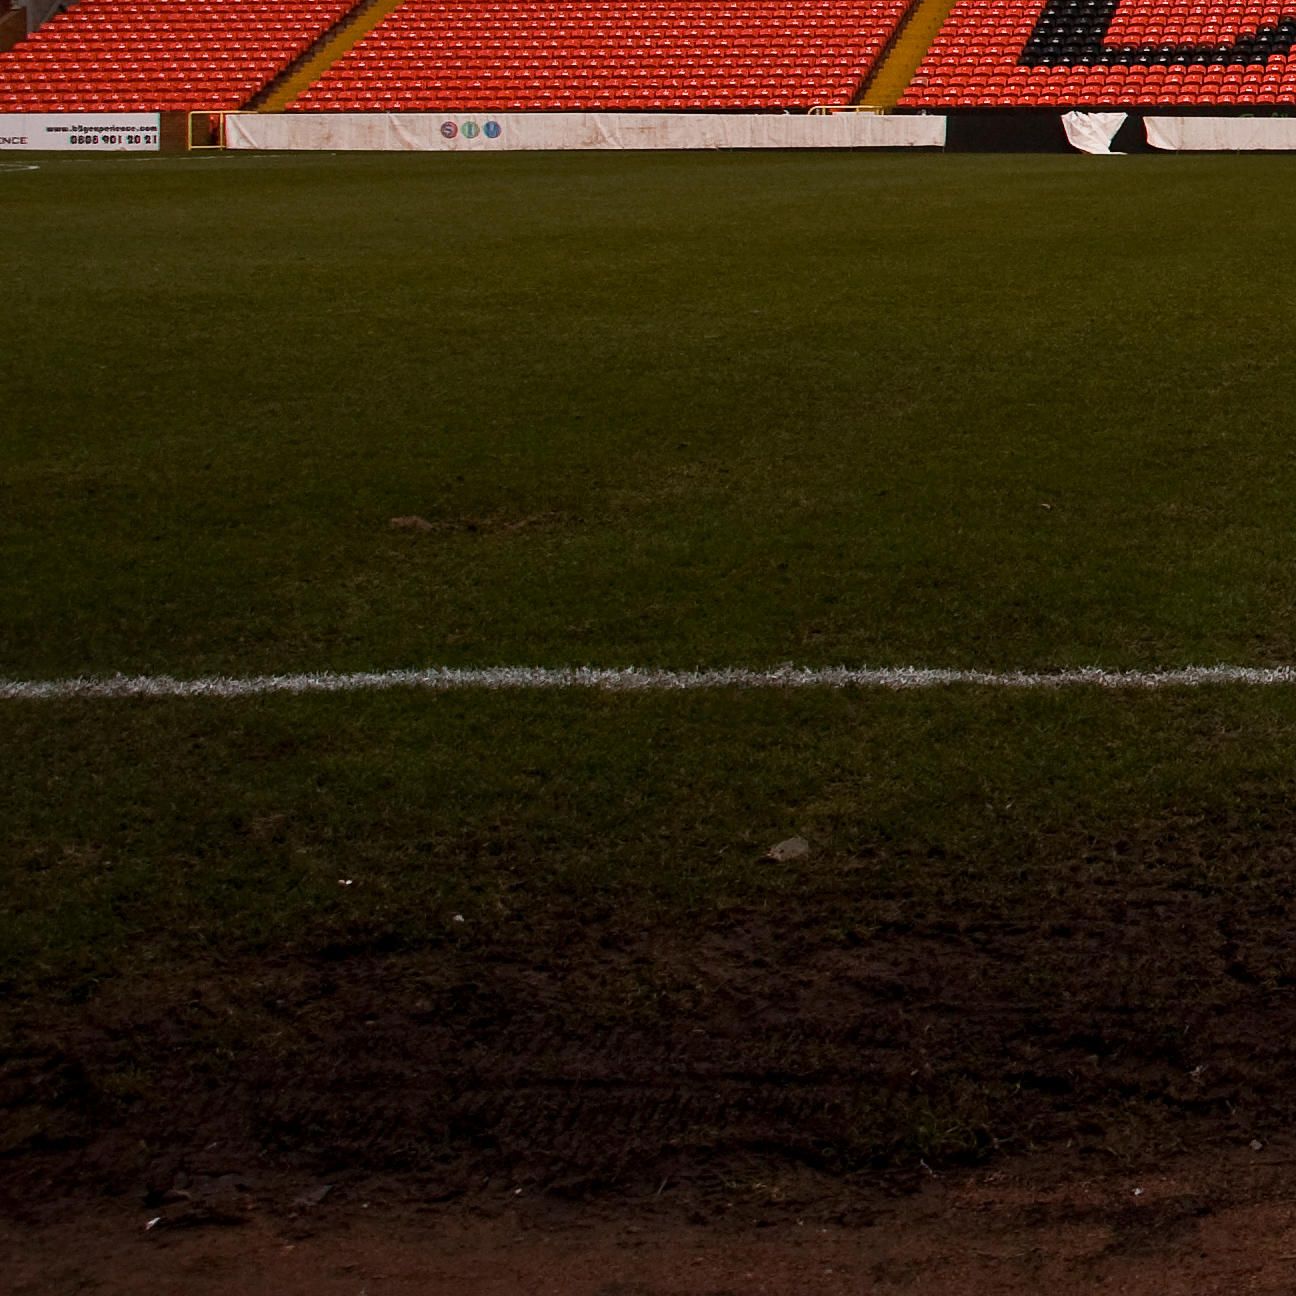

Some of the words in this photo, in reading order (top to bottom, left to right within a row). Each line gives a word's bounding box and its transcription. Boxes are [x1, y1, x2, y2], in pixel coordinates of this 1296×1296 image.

[102, 135, 122, 144] 901
[127, 135, 141, 144] 20
[144, 135, 157, 144] 21
